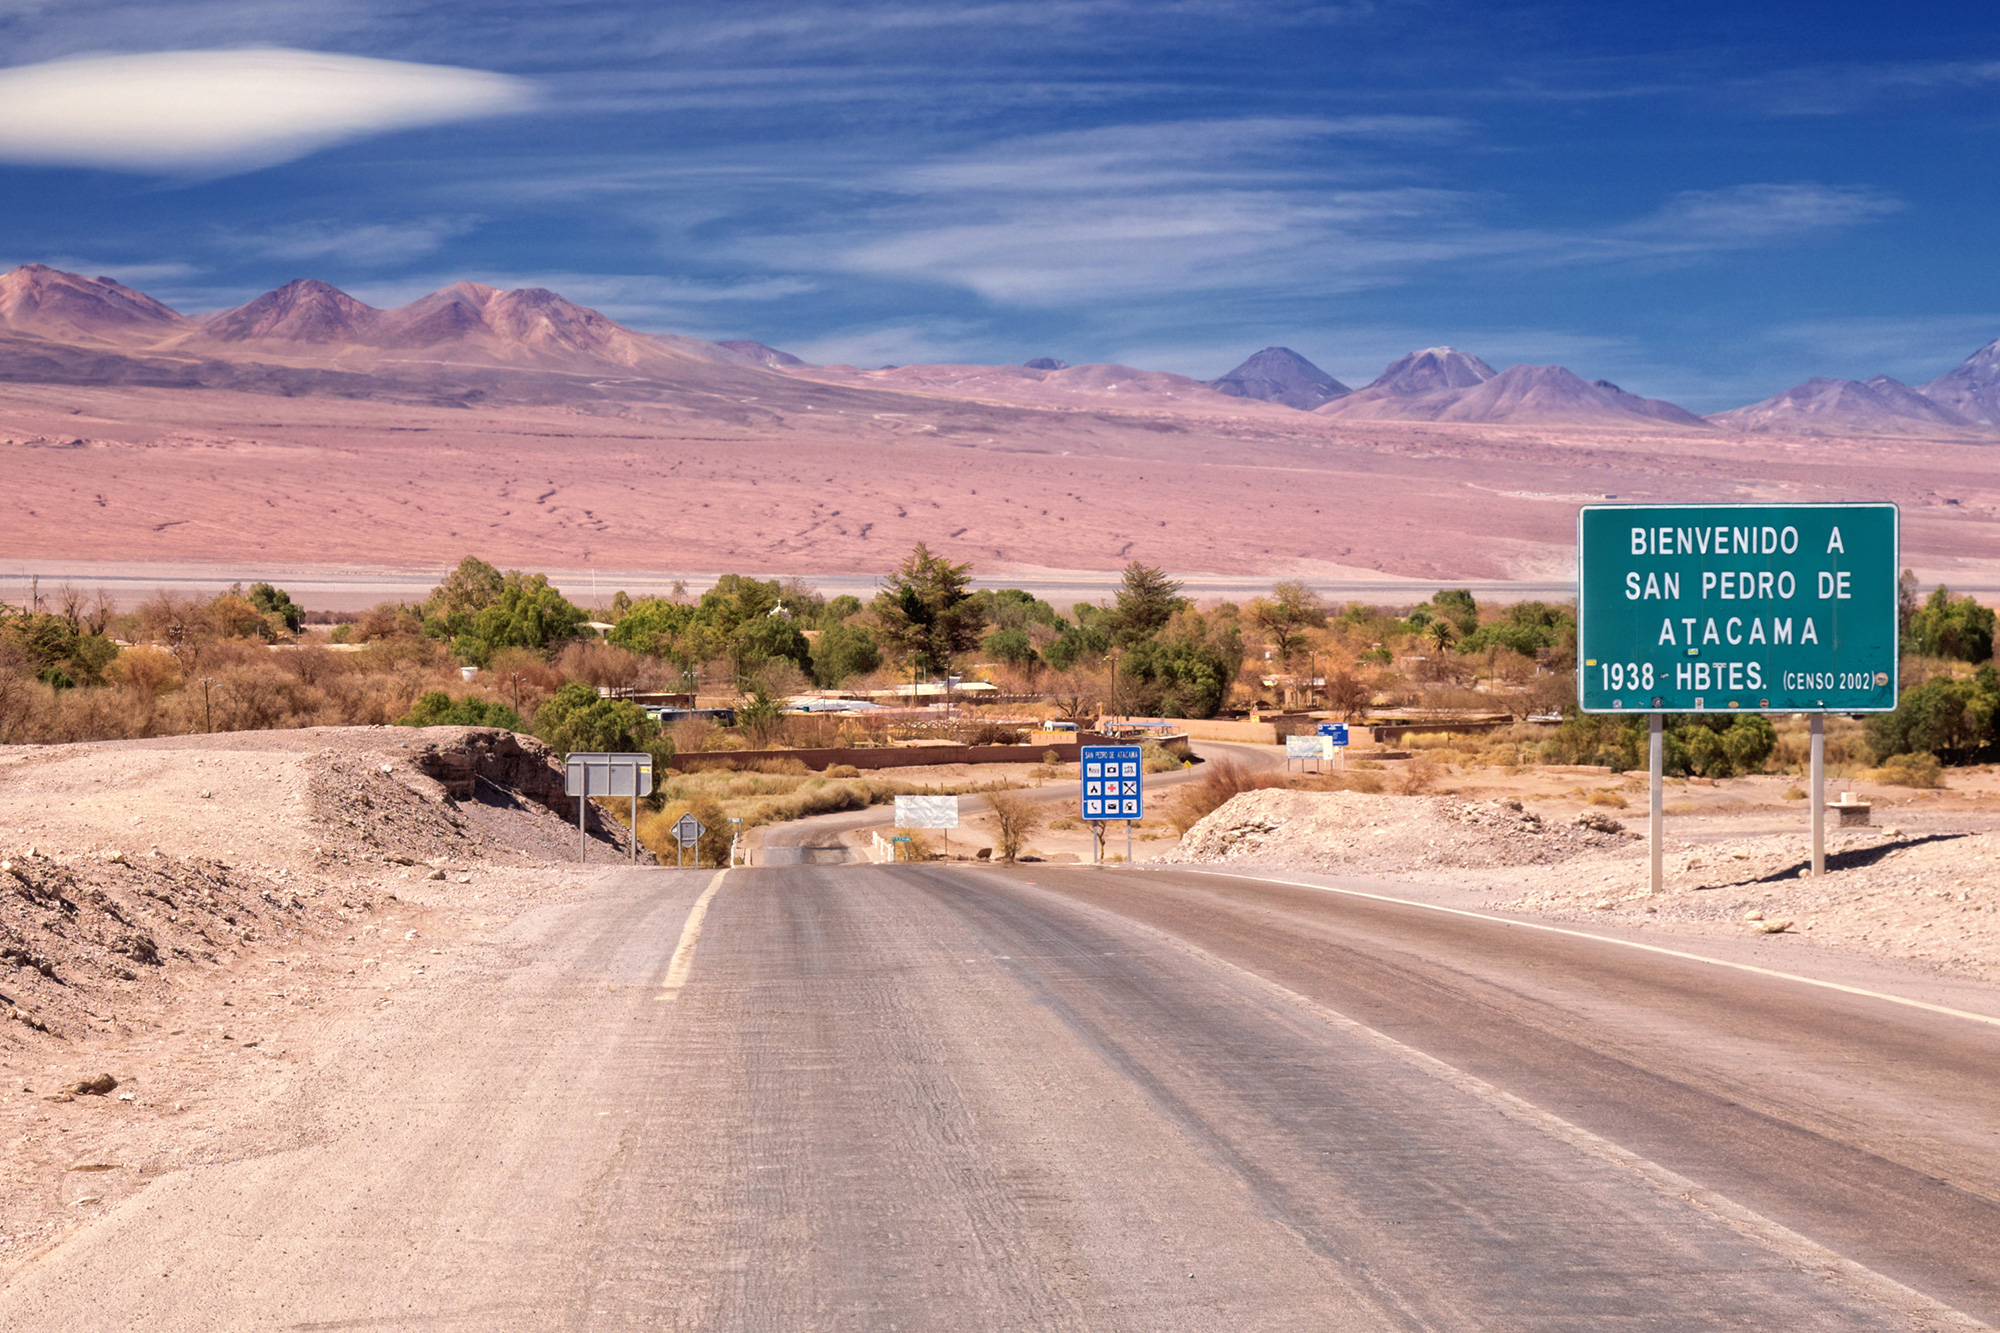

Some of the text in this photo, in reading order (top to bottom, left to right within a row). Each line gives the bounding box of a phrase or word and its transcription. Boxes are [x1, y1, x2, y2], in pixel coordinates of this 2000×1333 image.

[1631, 526, 1845, 555] BIENVENIDO A
[1625, 571, 1851, 600] SAN PEDRO DE
[1658, 617, 1819, 646] ATACAMA
[1601, 661, 1875, 691] 1938 HBTES. (CENSO 2002)
[1085, 751, 1138, 759] SAN PEDRO DE ATACAMA
